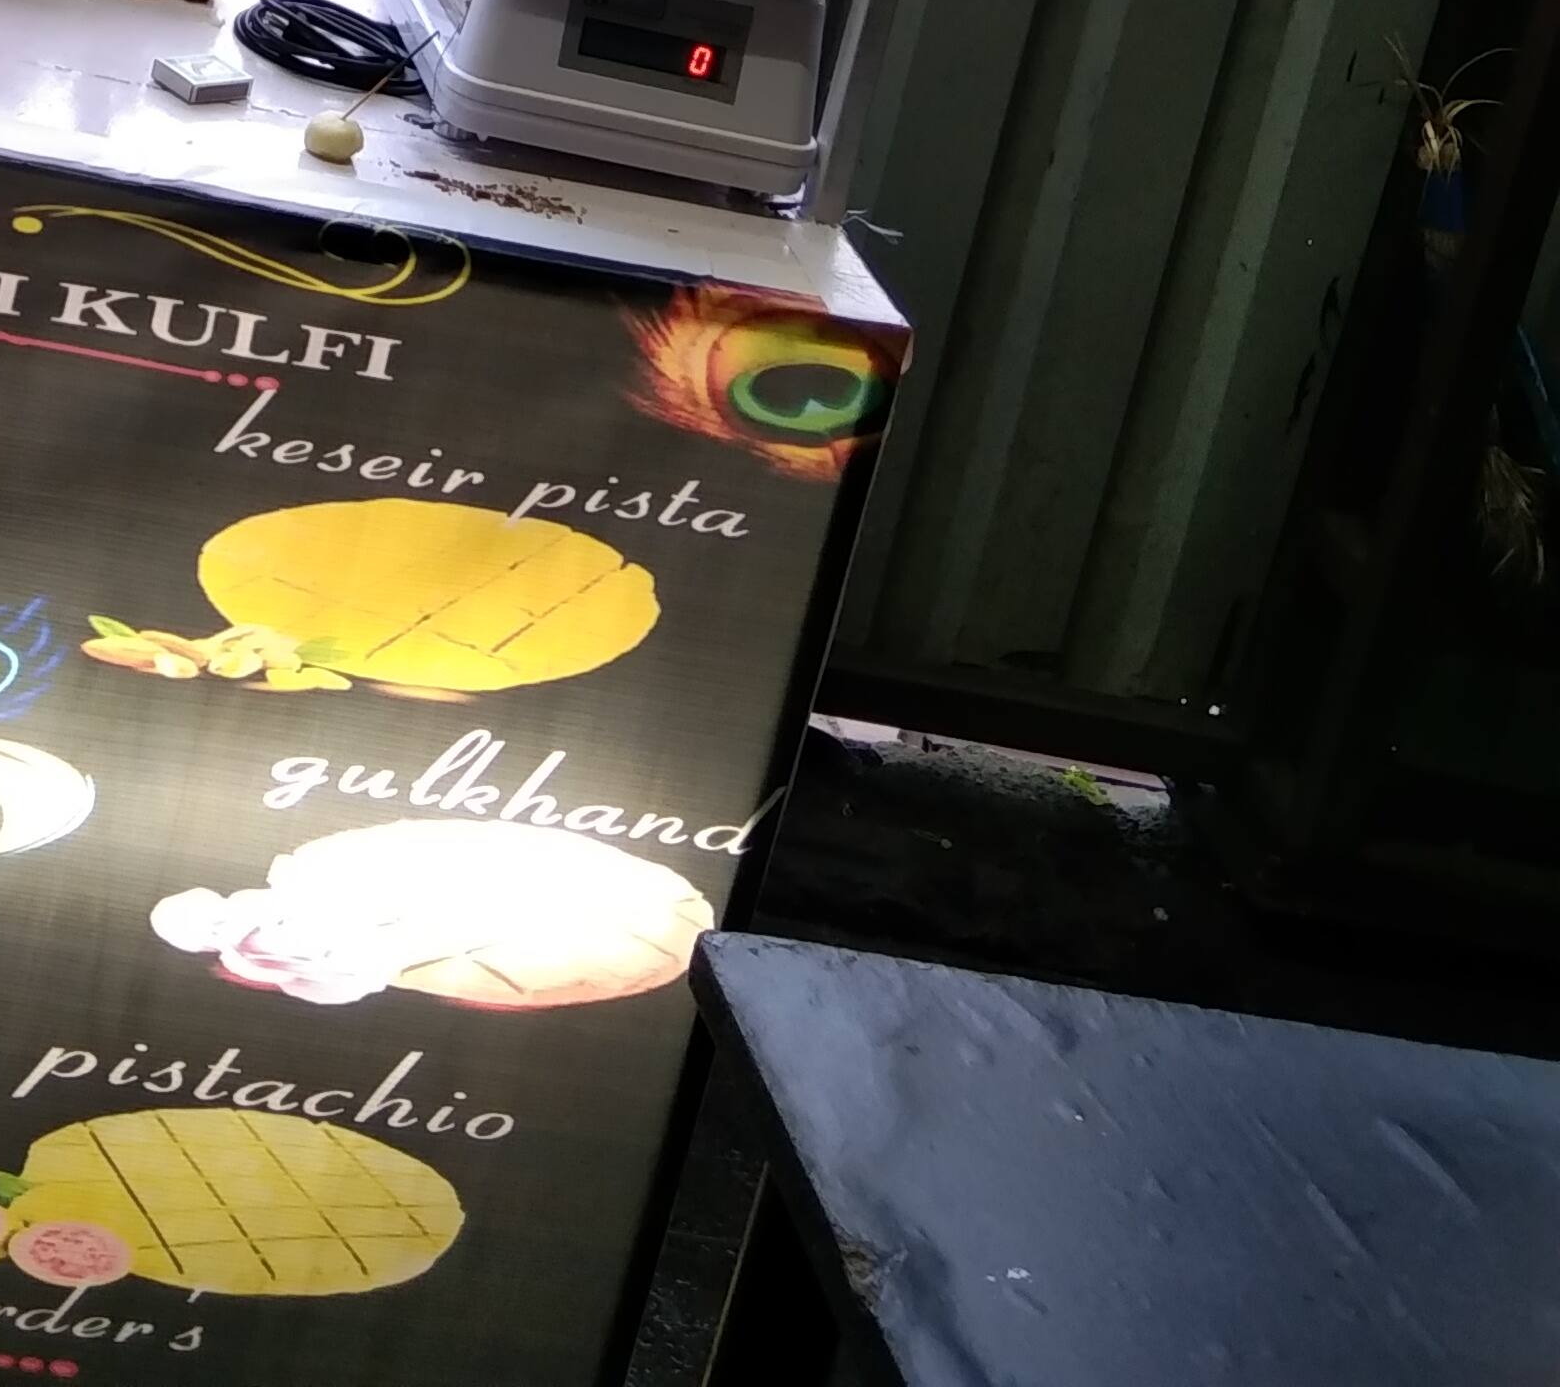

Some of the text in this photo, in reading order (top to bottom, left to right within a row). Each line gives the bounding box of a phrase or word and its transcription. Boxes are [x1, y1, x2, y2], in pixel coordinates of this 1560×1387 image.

[688, 44, 713, 77] 0
[47, 280, 402, 382] KULFI
[214, 388, 751, 538] keseir pista
[262, 728, 786, 856] gulkhand
[11, 1040, 517, 1142] pistachio
